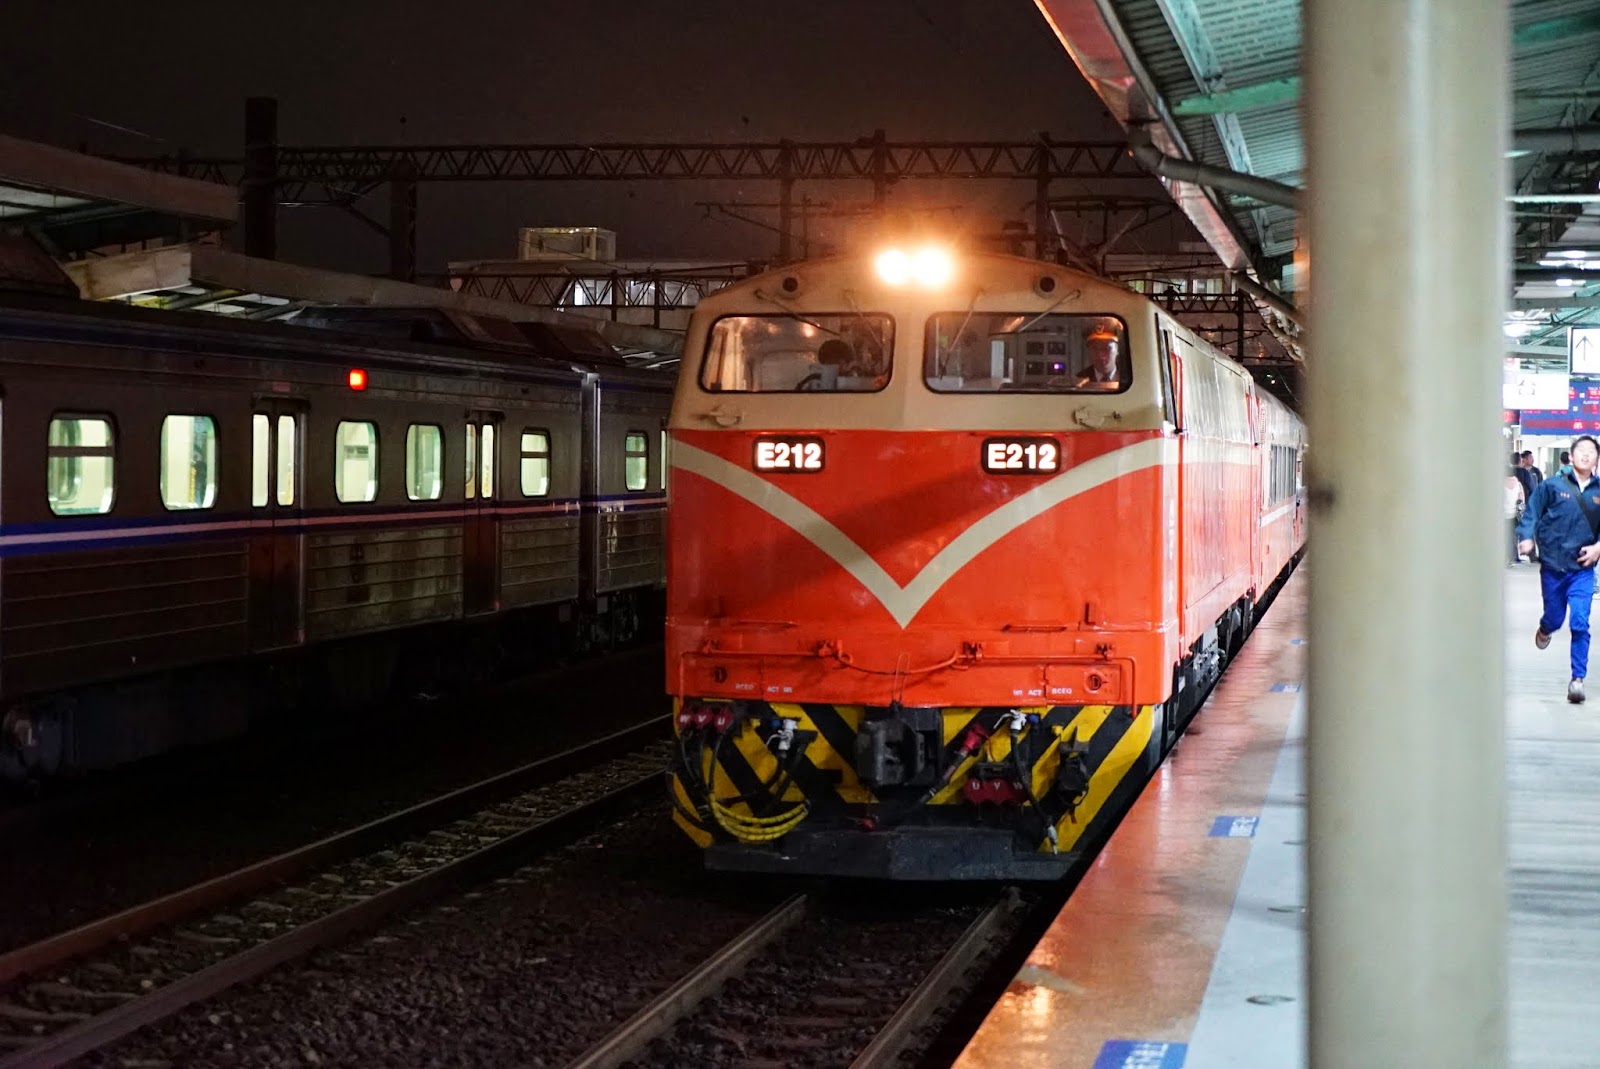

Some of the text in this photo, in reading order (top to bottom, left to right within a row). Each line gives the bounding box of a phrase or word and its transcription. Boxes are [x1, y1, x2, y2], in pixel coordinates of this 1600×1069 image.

[756, 442, 822, 470] E212
[986, 443, 1057, 471] E212
[698, 714, 707, 723] V
[717, 717, 726, 726] U
[972, 781, 981, 791] U
